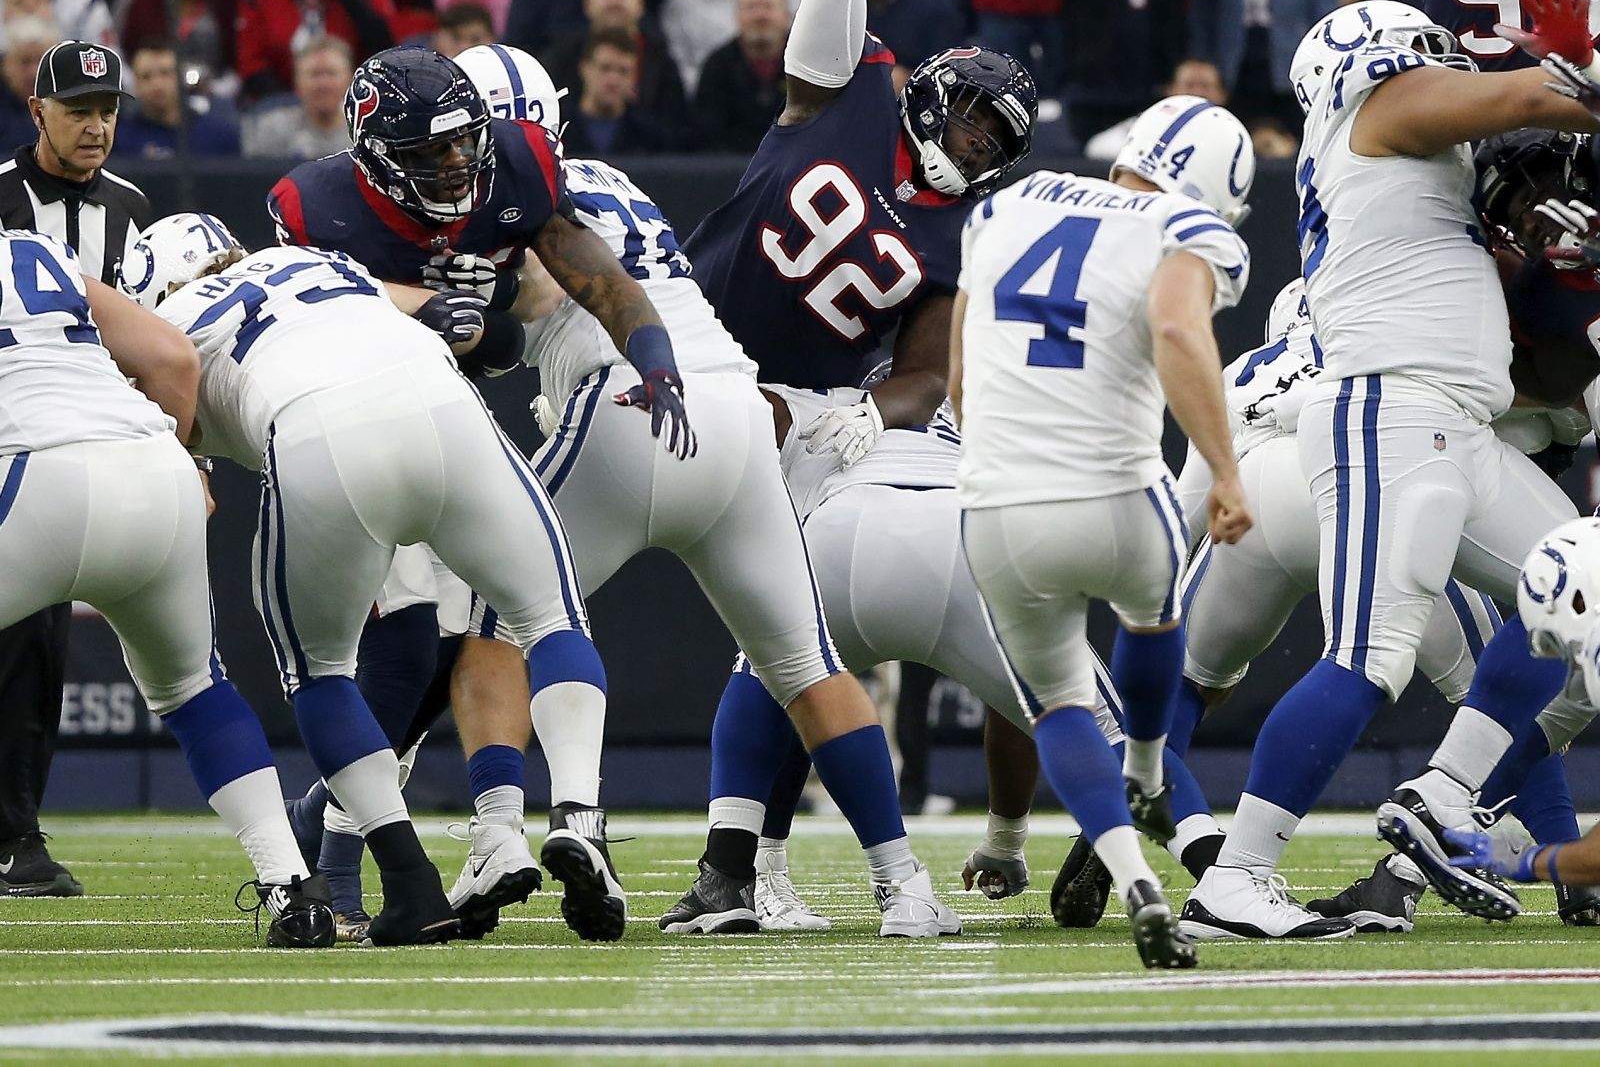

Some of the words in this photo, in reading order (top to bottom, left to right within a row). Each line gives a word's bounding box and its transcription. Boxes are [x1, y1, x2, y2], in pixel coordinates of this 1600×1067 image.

[1170, 145, 1196, 180] 4
[872, 186, 906, 230] TEXANS
[762, 160, 920, 339] 92
[993, 217, 1102, 370] 4
[61, 683, 138, 735] ESS
